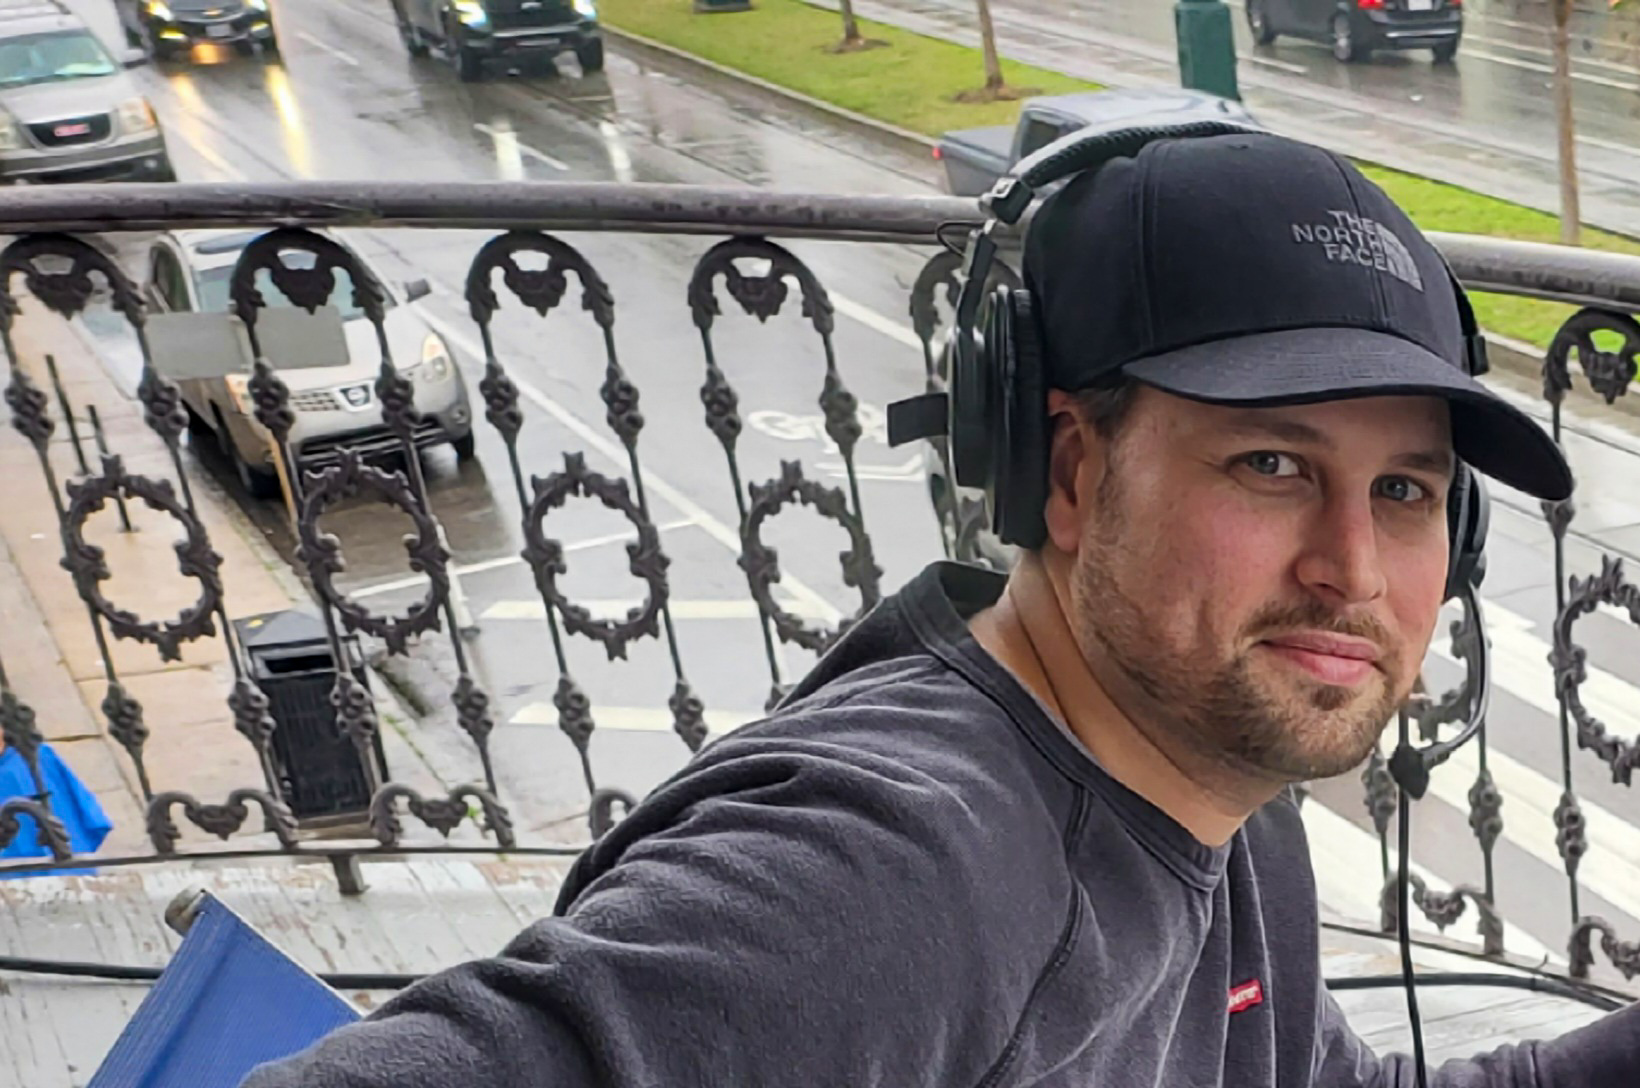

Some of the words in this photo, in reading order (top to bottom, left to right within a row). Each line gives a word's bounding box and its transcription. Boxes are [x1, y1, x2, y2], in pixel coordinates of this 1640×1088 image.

[1291, 223, 1384, 250] NORTH
[1327, 210, 1376, 236] THE
[1323, 243, 1388, 272] FACE
